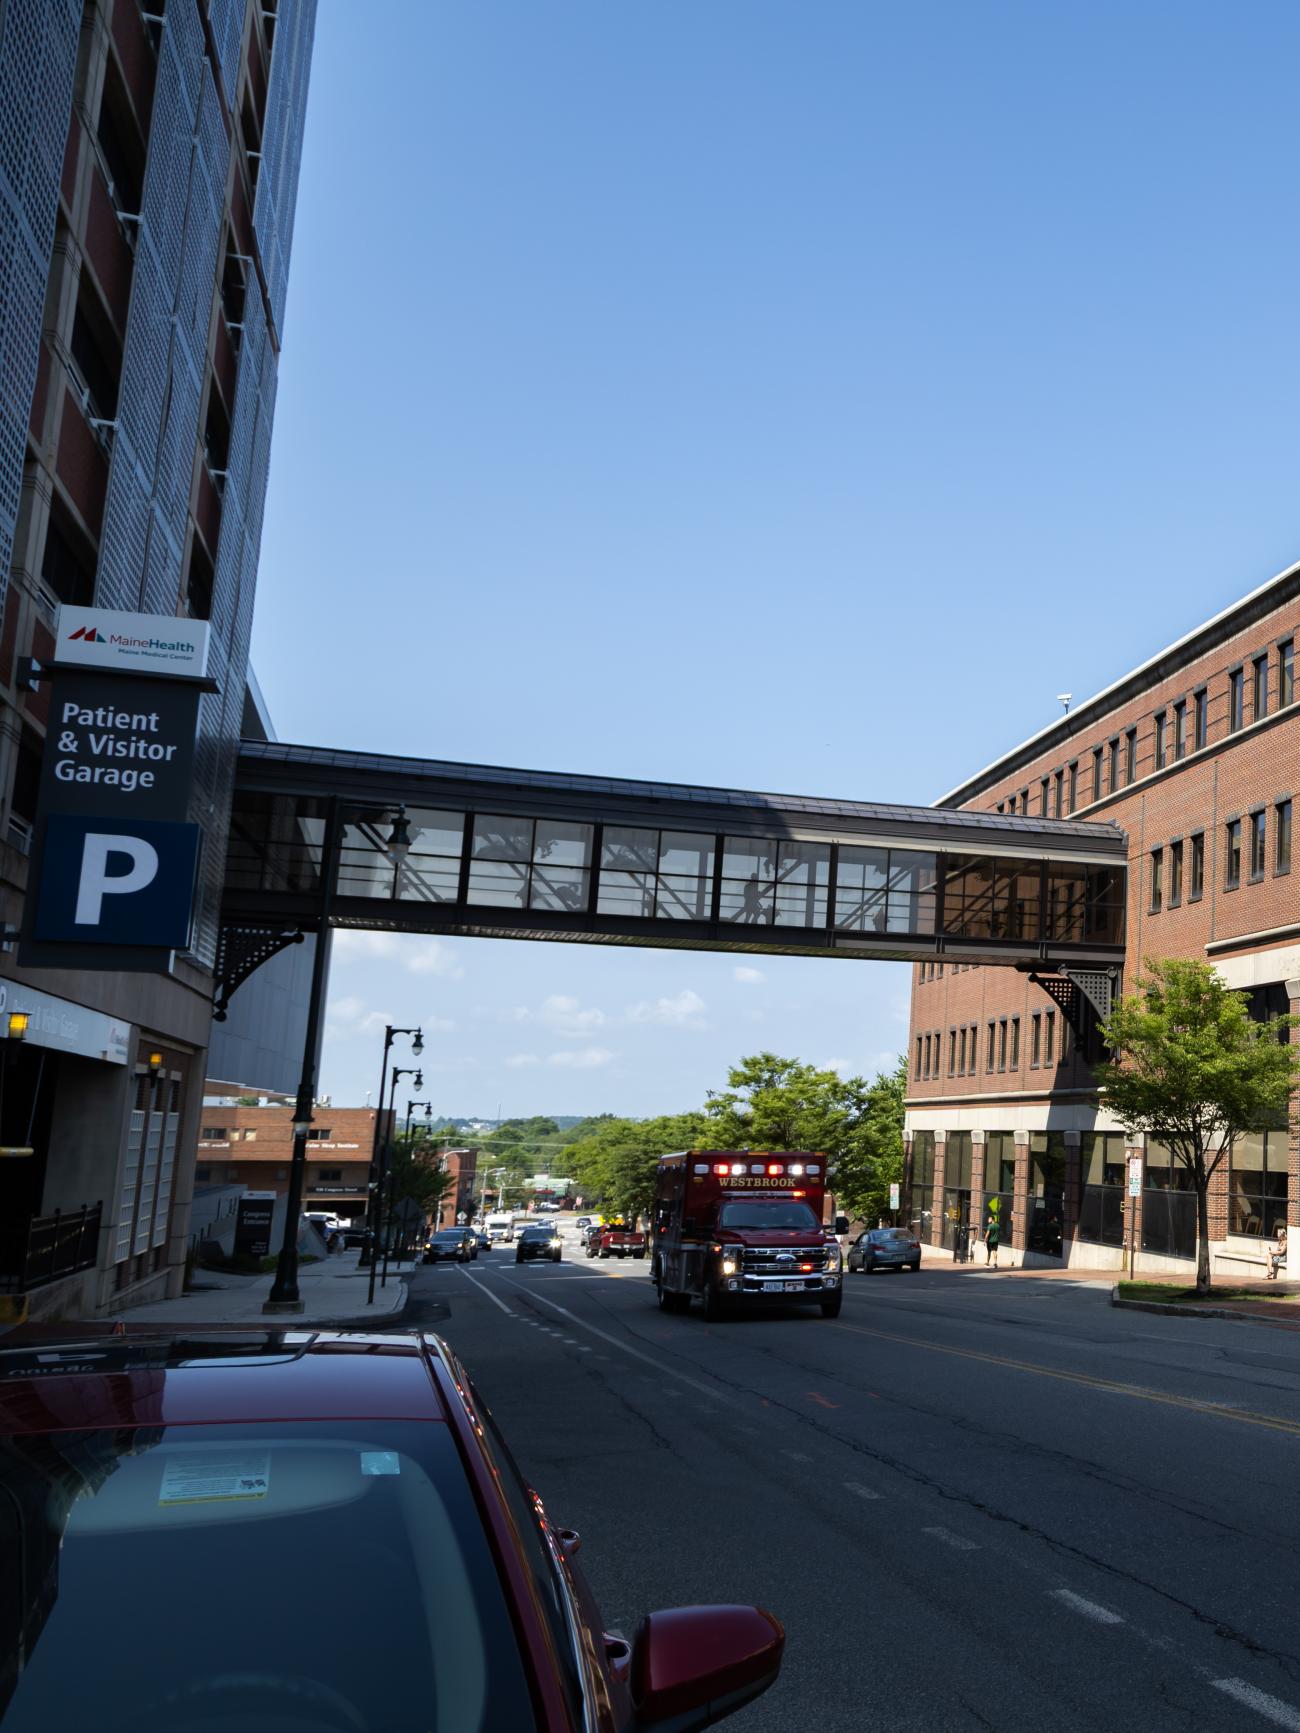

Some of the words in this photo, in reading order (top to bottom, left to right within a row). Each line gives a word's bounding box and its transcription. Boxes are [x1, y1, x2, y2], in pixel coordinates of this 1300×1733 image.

[110, 634, 194, 653] MaineHealth
[118, 648, 139, 656] Maine
[141, 650, 168, 659] Medical
[62, 702, 159, 732] Patient
[57, 731, 78, 753] &
[89, 733, 177, 761] Visitor
[55, 759, 155, 792] Garage
[75, 833, 158, 925] P
[719, 1177, 796, 1187] WESTBROOK
